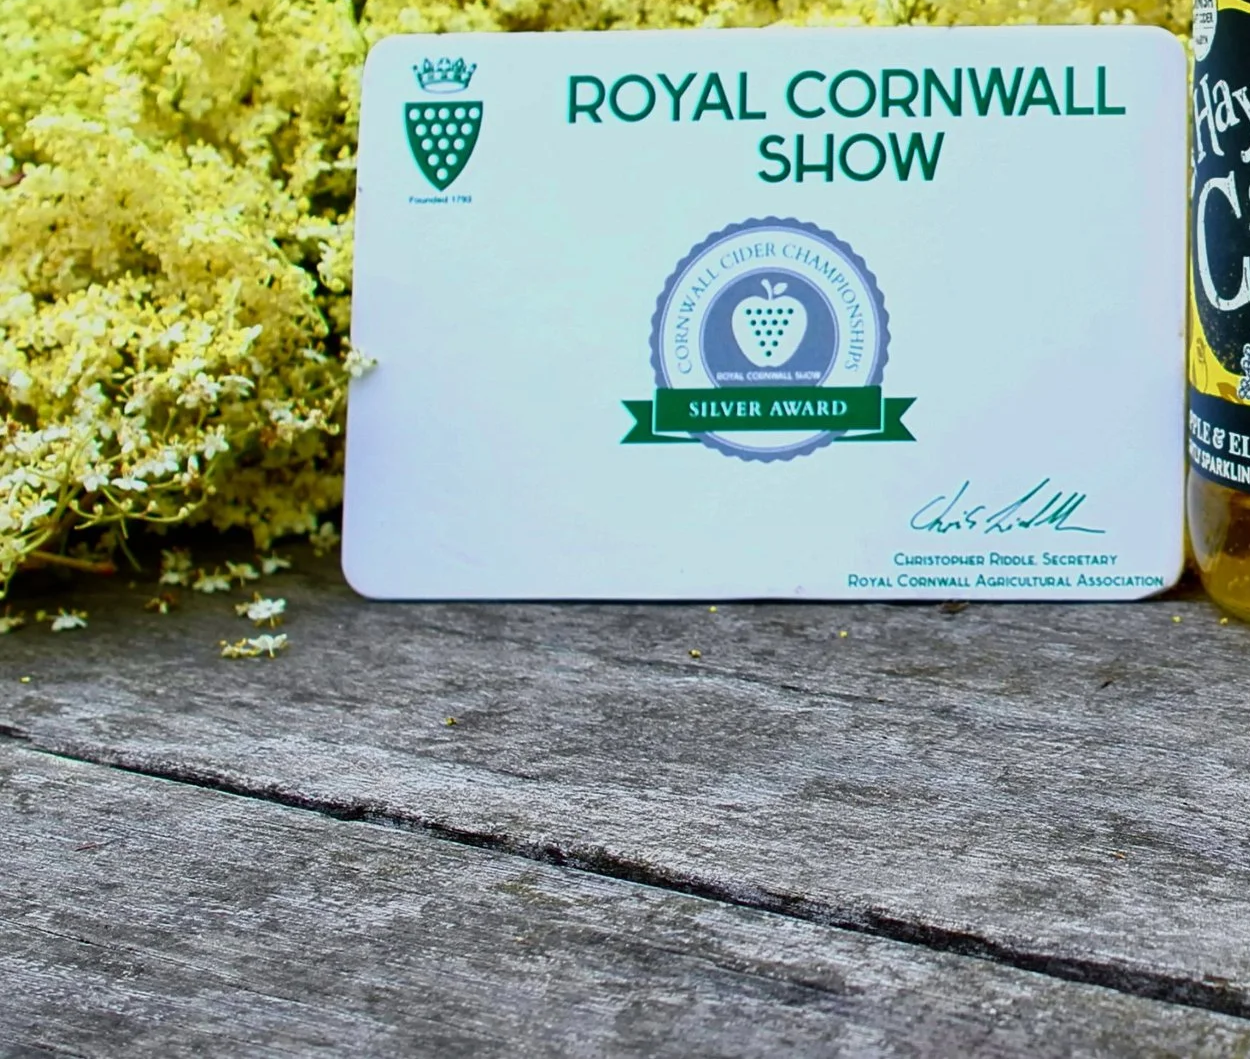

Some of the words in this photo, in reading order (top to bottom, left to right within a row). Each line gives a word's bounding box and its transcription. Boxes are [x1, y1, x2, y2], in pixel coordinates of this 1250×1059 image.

[568, 71, 767, 124] ROYAL
[785, 66, 1126, 119] CORNWALL
[758, 131, 945, 183] SHOW
[675, 268, 719, 374] CORNWALL
[720, 242, 776, 270] CIDER
[782, 242, 864, 372] CHAMPIONSHIPS
[689, 401, 762, 417] SILVER
[769, 399, 848, 416] AWARD
[893, 552, 985, 566] CHRISTOPHER
[1042, 552, 1118, 566] SECRETARY
[848, 574, 893, 587] ROYAL
[897, 574, 970, 587] CORNWALL
[975, 574, 1072, 587] AGRICULTURAL
[1077, 574, 1164, 587] ASSOCIATION
